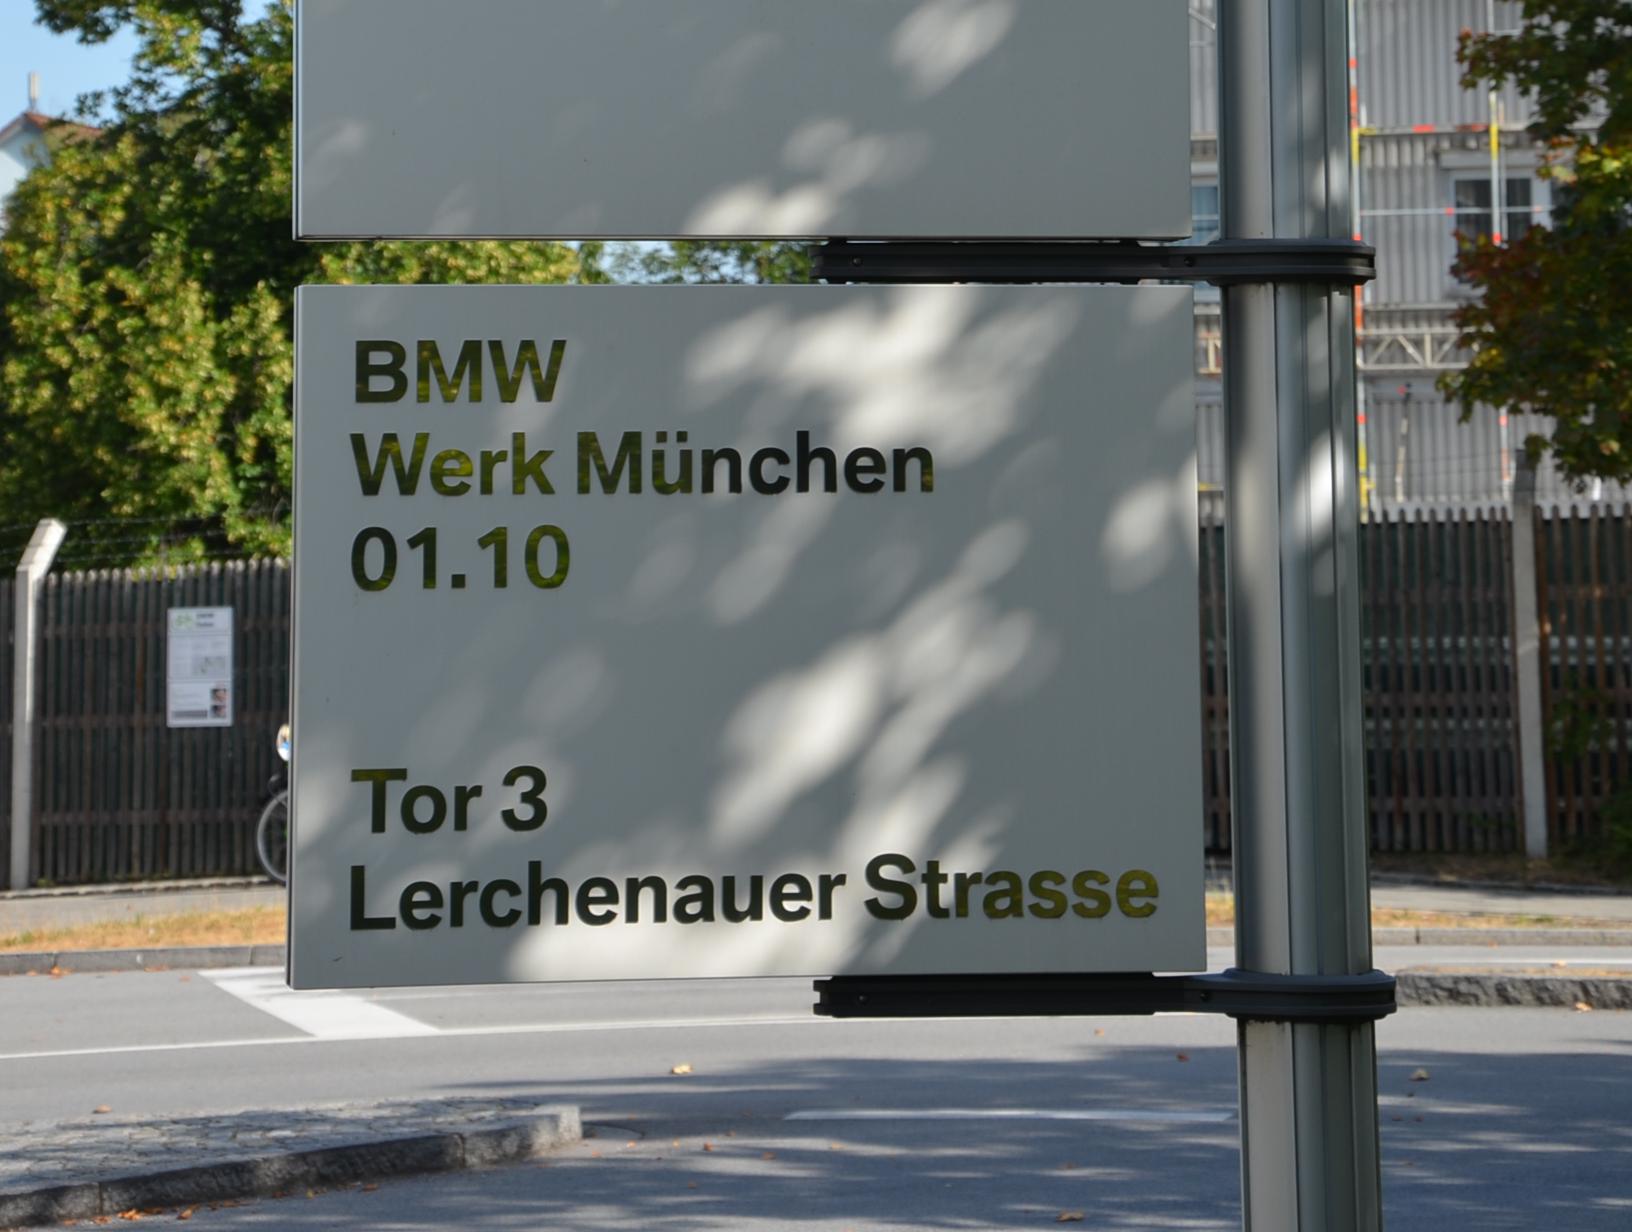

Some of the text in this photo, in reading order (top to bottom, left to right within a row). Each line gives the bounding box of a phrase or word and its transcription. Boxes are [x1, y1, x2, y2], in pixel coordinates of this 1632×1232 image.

[354, 338, 567, 404] BMW
[349, 429, 935, 497] Werk München
[350, 524, 571, 591] 01.10
[350, 765, 549, 835] Tor 3
[349, 853, 1160, 931] Lerchenauer Strasse
